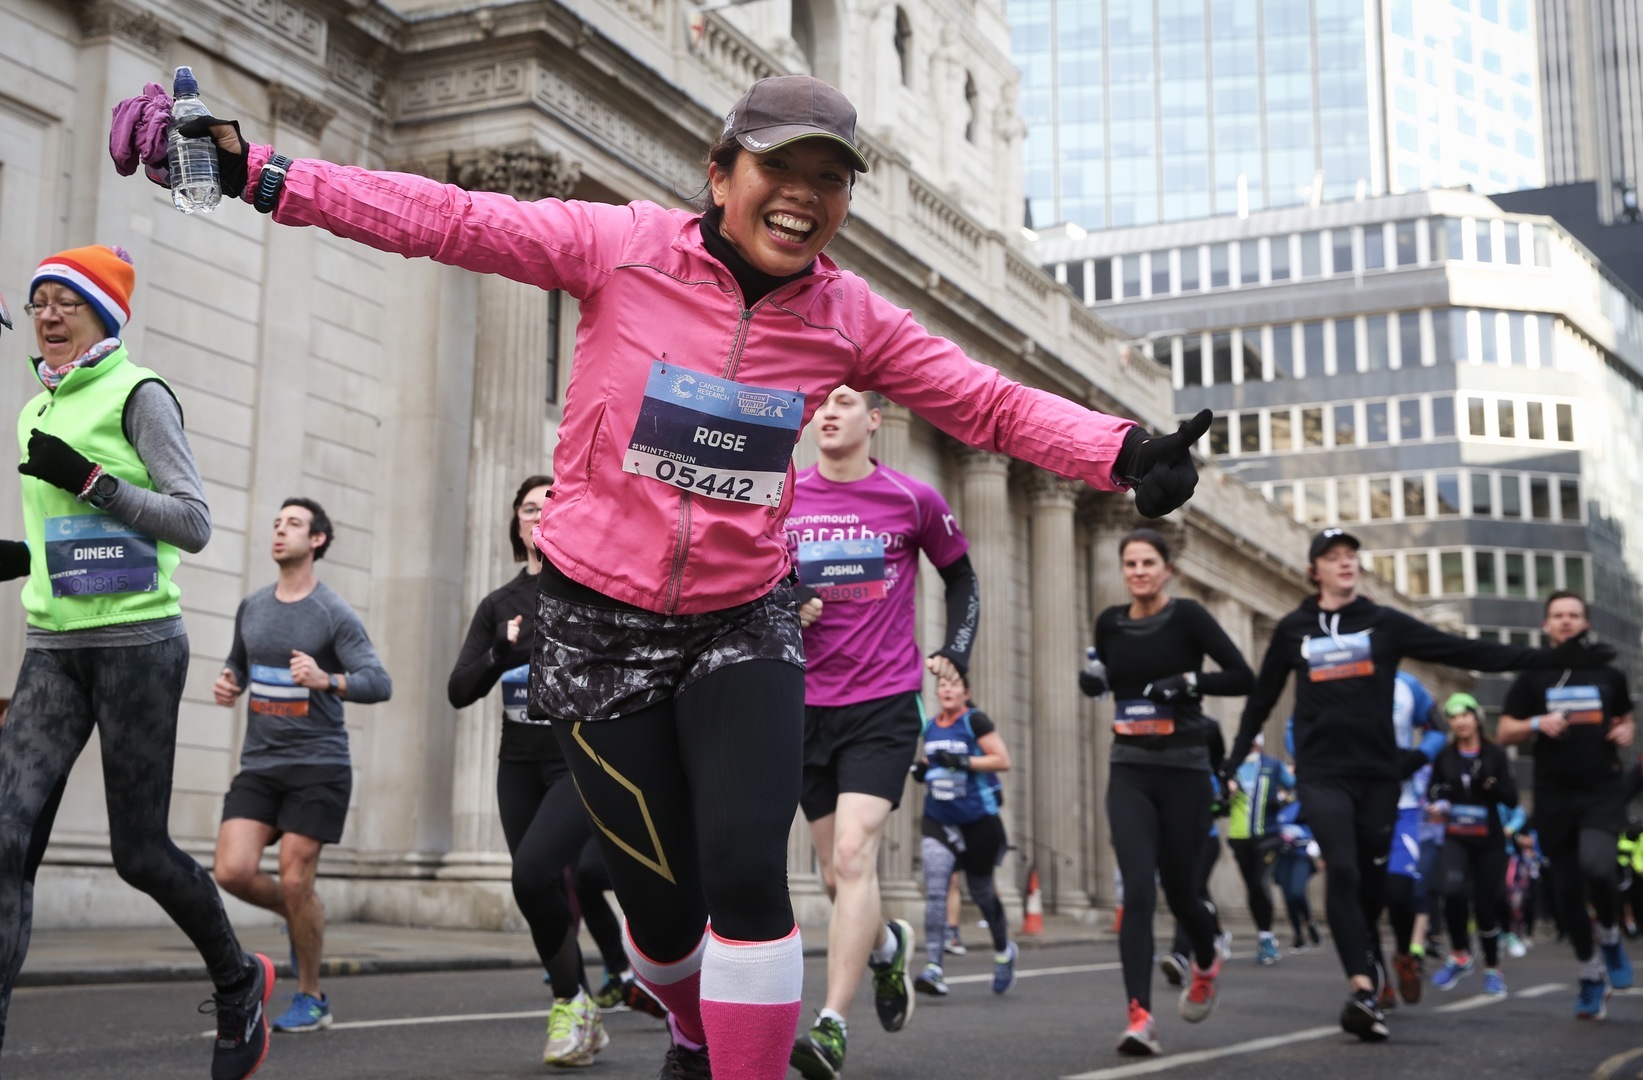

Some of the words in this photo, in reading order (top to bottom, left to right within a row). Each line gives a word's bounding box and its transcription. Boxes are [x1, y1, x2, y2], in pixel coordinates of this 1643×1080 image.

[698, 381, 725, 394] CANCER
[695, 394, 706, 402] UK
[696, 388, 730, 401] RESEARCH
[742, 393, 766, 402] LONDON
[740, 400, 764, 408] WINTER
[742, 407, 757, 415] RUN
[693, 426, 748, 452] ROSE
[632, 442, 697, 464] #WINTERRUN
[655, 460, 754, 502] 05442
[73, 545, 124, 561] DINEKE
[821, 564, 865, 577] JOSHUA
[70, 575, 129, 594] 01815
